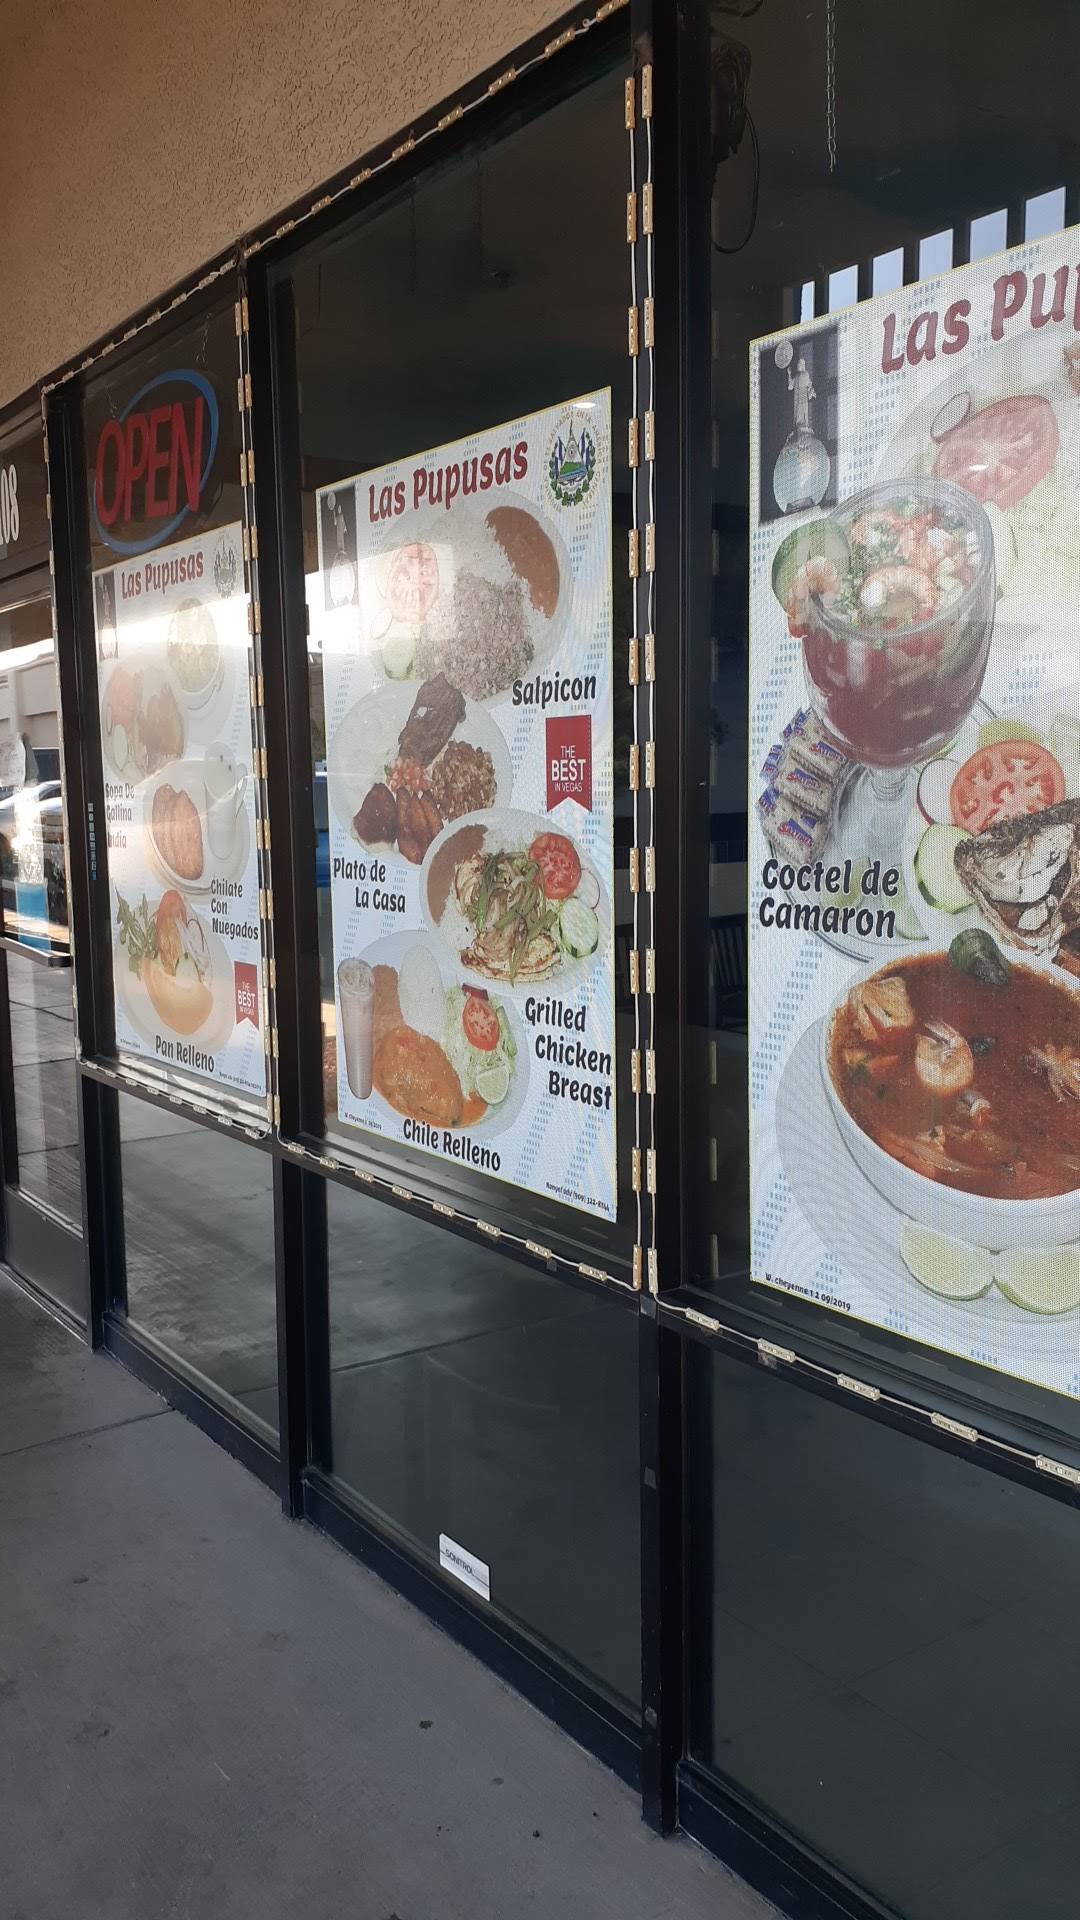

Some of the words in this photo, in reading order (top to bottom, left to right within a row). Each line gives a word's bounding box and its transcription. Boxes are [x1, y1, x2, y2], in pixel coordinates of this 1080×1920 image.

[881, 299, 971, 375] Las
[990, 264, 1080, 342] Pu
[95, 396, 205, 527] OPEN
[369, 481, 406, 523] Las
[413, 441, 528, 510] Pupusas
[0, 464, 20, 545] 08
[121, 571, 141, 600] Las
[145, 551, 204, 595] Pupusas
[512, 671, 597, 710] Salpicon
[560, 745, 576, 758] THE
[551, 759, 587, 781] BEST
[105, 783, 124, 801] Sopa
[554, 782, 561, 792] IN
[561, 782, 583, 793] VEGAS
[107, 803, 132, 823] Gallina
[333, 857, 366, 881] Plato
[370, 859, 386, 882] de
[762, 858, 852, 895] Coctel
[860, 859, 900, 897] de
[211, 877, 243, 898] Chilate
[355, 886, 369, 909] La
[373, 888, 406, 913] Casa
[211, 898, 228, 915] Con
[758, 896, 897, 939] Camaron
[212, 917, 259, 940] Nuegados
[237, 989, 256, 1008] BEST
[242, 980, 251, 992] THE
[525, 996, 587, 1033] Grilled
[155, 1034, 174, 1059] Pan
[176, 1042, 215, 1073] Relleno
[535, 1033, 612, 1076] Chicken
[548, 1069, 612, 1110] Breast
[403, 1118, 439, 1150] Chile
[443, 1130, 501, 1172] Relleno
[821, 1293, 851, 1312] 09/2019
